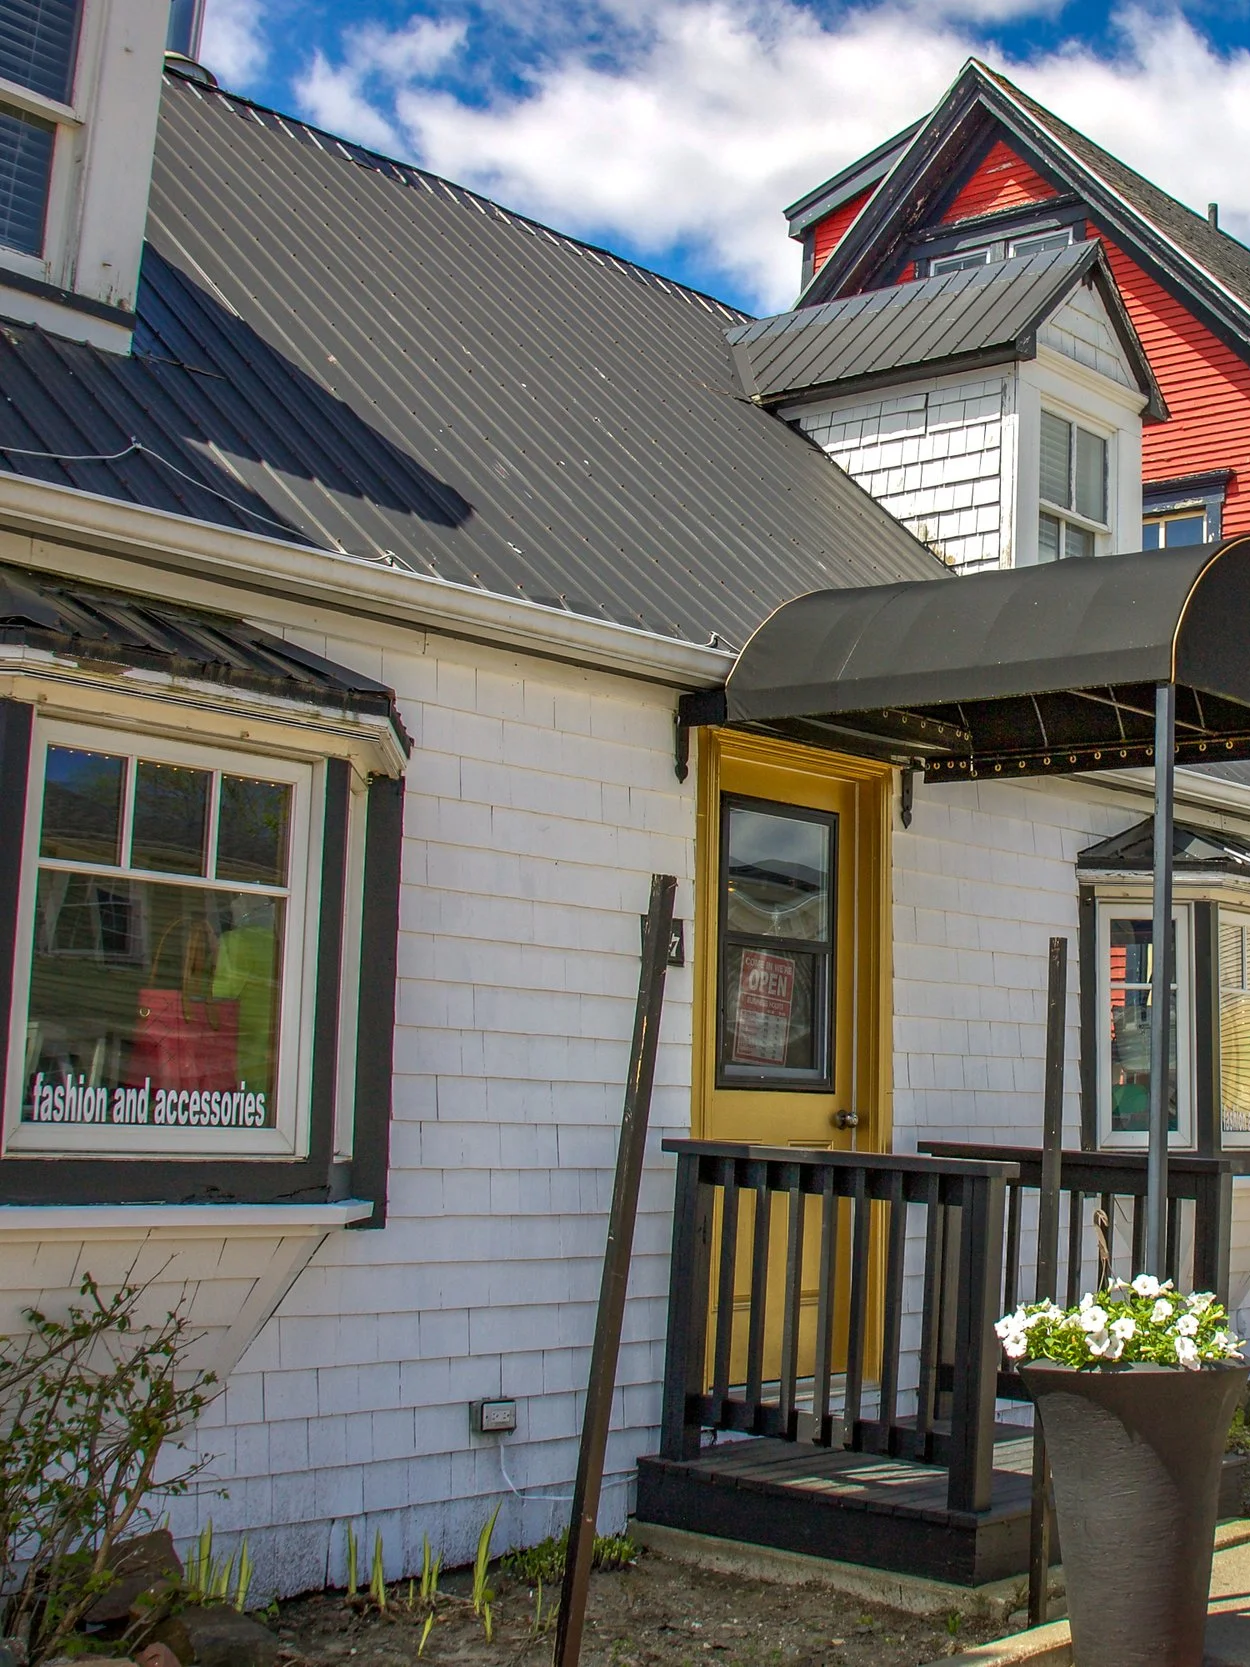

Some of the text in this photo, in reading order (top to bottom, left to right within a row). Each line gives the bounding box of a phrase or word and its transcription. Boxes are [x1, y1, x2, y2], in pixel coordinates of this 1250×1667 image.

[749, 969, 788, 998] OPEN
[33, 1072, 265, 1128] fashion and accessories
